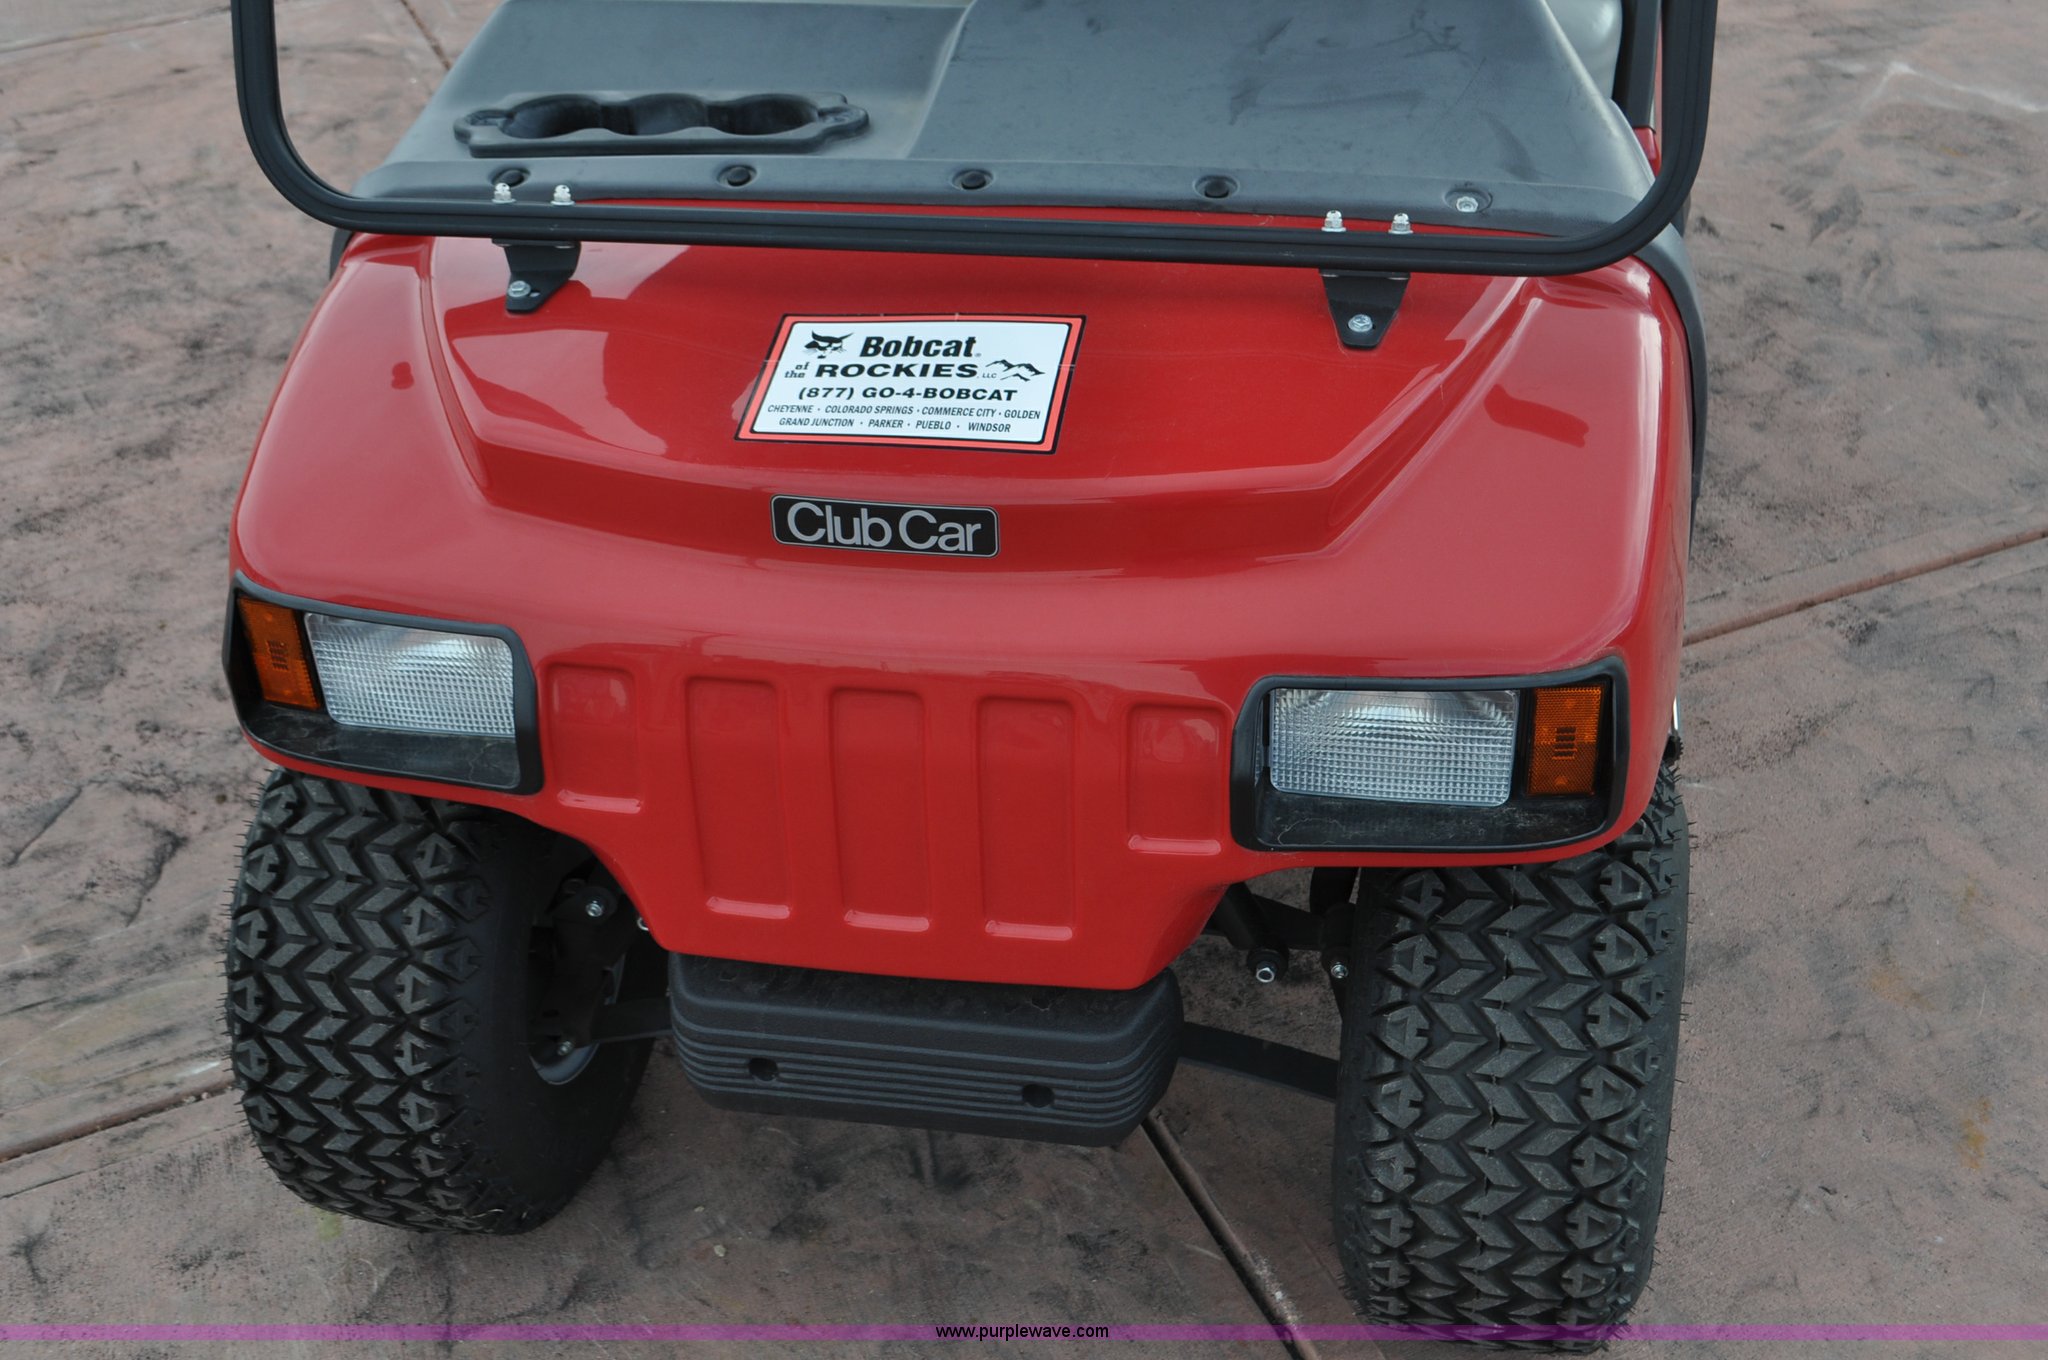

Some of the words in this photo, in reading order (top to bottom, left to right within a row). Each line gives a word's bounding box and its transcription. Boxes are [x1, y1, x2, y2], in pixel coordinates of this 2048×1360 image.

[859, 335, 976, 357] Bobcat
[784, 370, 805, 378] the
[815, 363, 978, 378] ROCKIES
[798, 387, 854, 400] (877)
[862, 387, 1018, 401] GO-4-BOBCAT
[767, 404, 814, 413] CHEYENNE
[825, 405, 872, 414] COLORADO
[874, 405, 914, 415] SPRINGS
[921, 406, 975, 417] COMMERCE
[976, 408, 997, 418] CITY
[1004, 409, 1041, 420] GOLDEN
[779, 417, 811, 426] GRAND
[811, 418, 854, 427] JUNCTION
[868, 419, 903, 429] PARKER
[915, 420, 952, 430] PUEBLO
[968, 421, 1011, 433] WINDSOR
[787, 501, 893, 547] Club
[899, 509, 981, 552] Car
